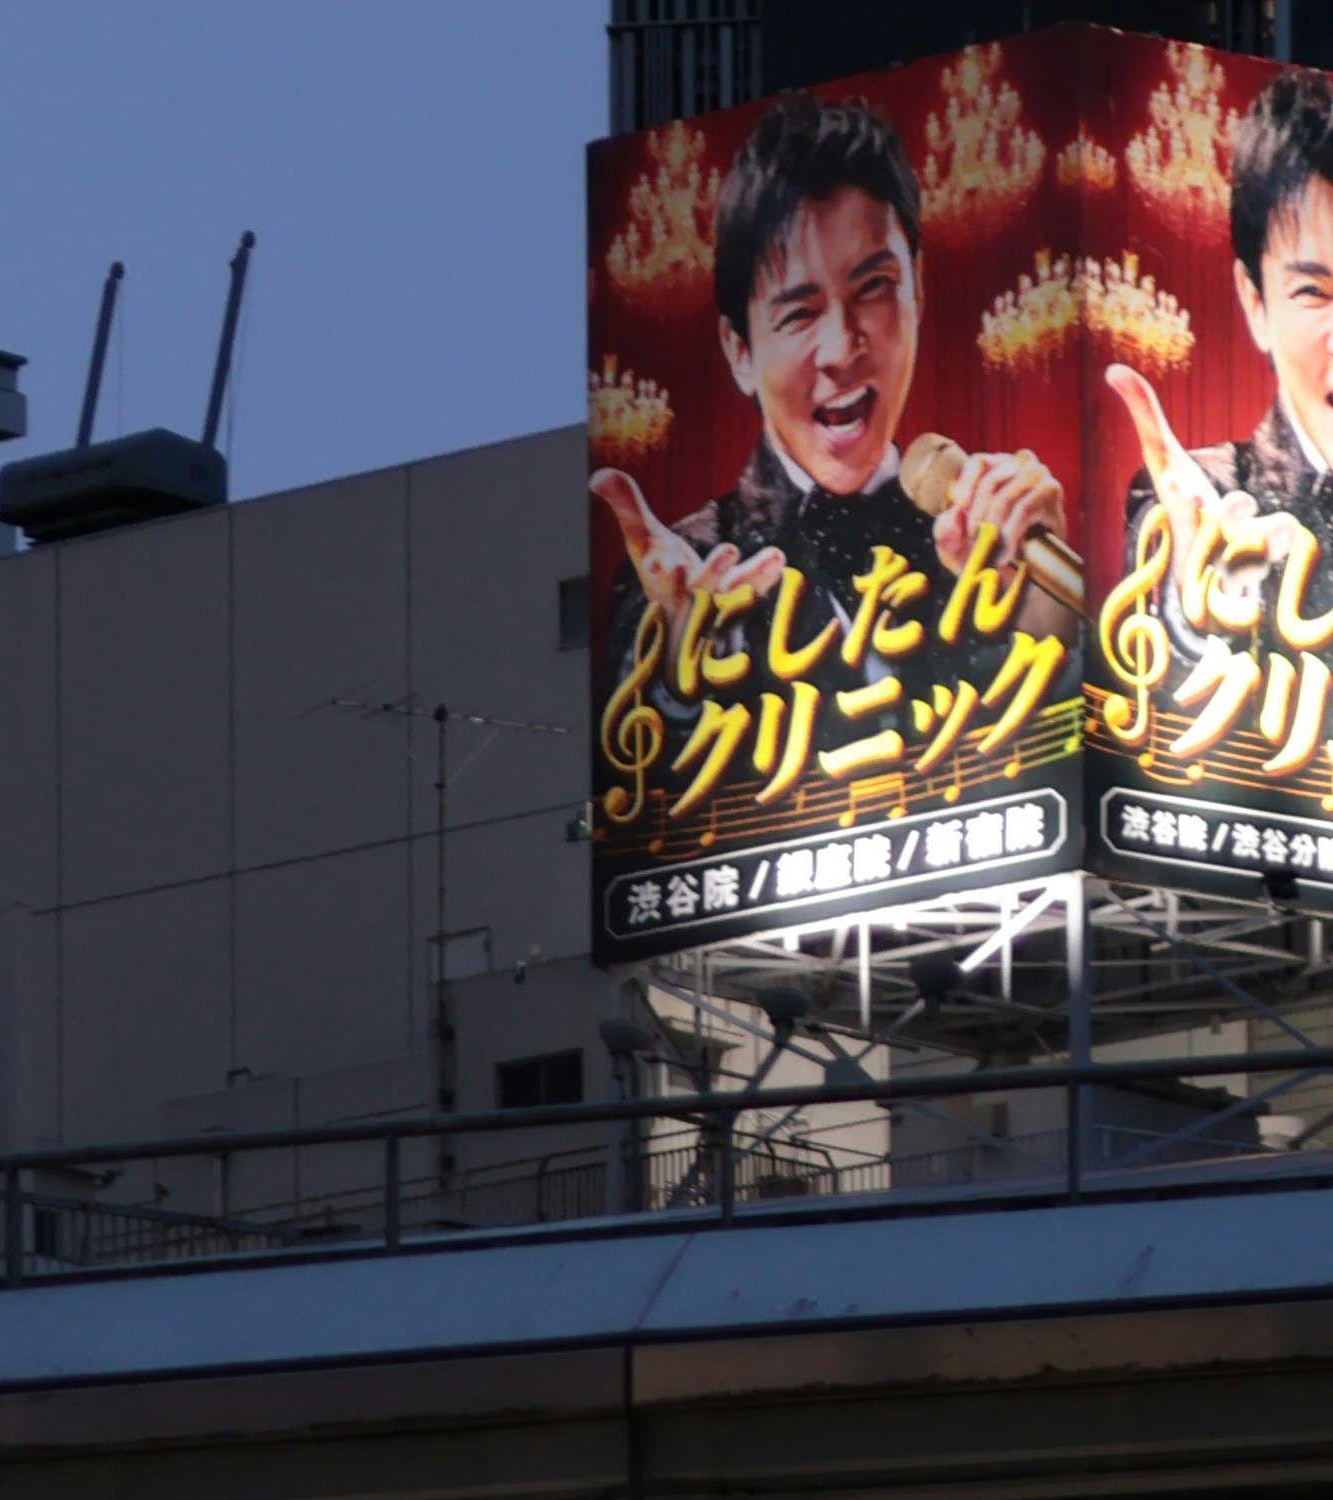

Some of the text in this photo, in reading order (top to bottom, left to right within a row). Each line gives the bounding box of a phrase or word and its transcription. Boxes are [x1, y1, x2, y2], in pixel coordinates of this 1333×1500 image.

[677, 521, 1030, 698] にしたん
[669, 631, 1069, 821] クリニック
